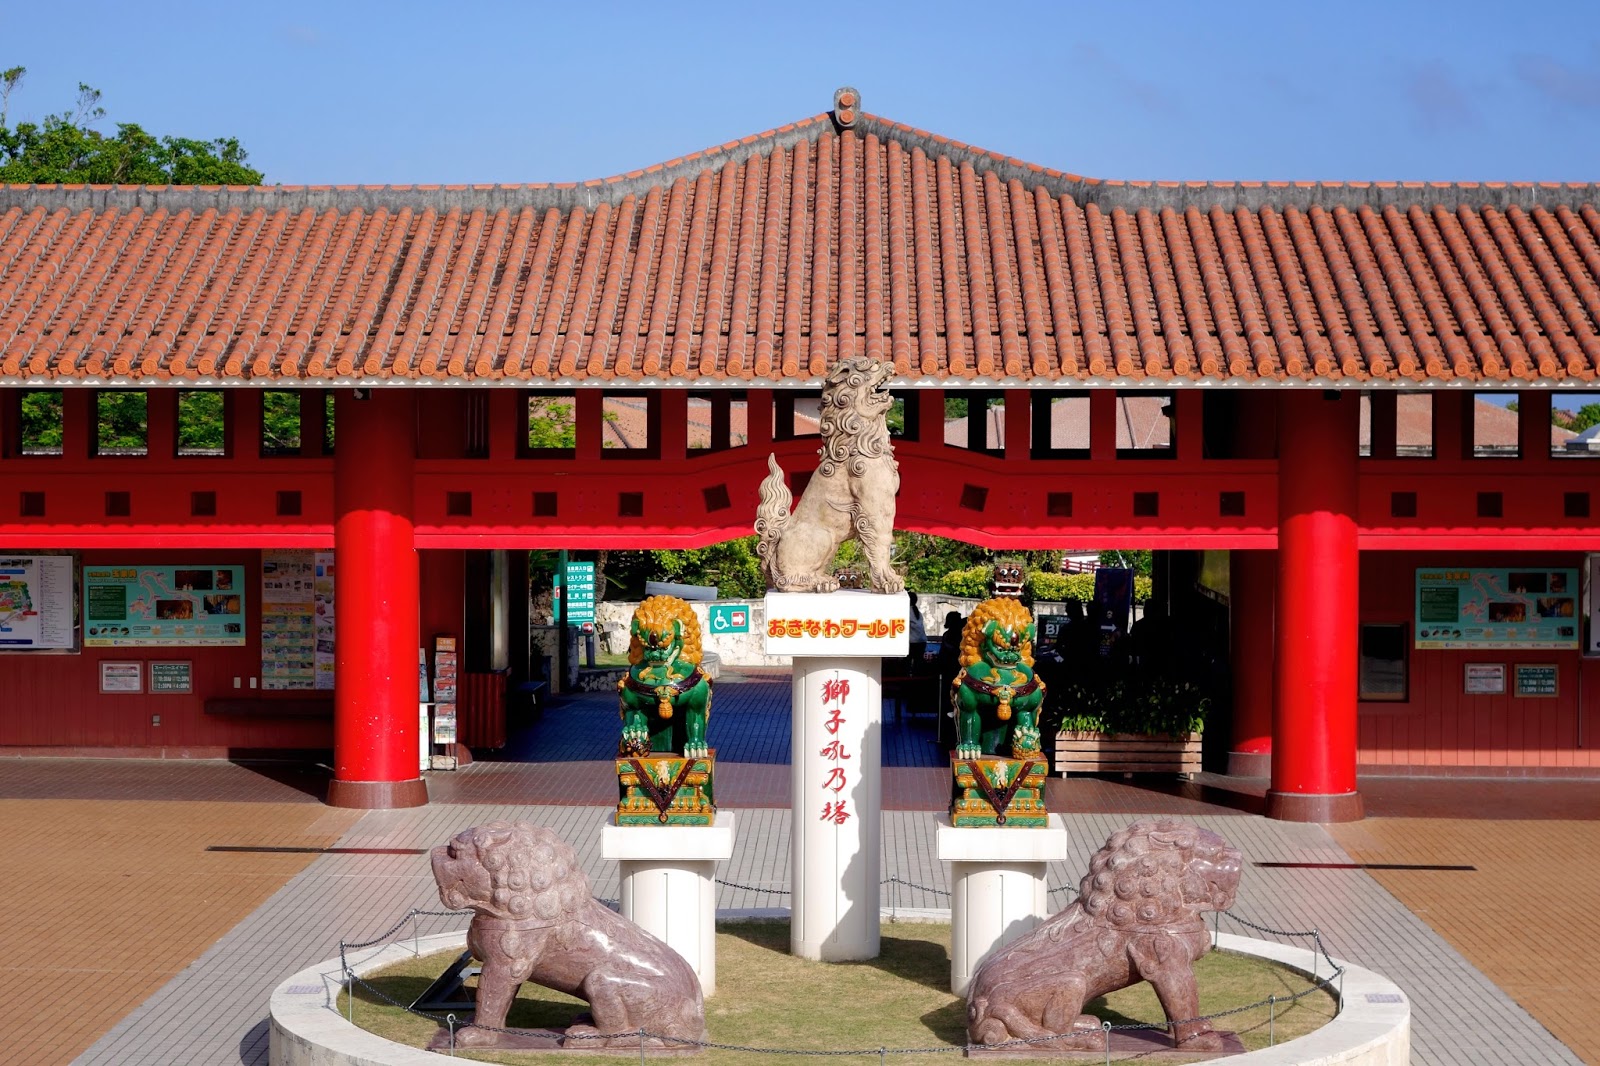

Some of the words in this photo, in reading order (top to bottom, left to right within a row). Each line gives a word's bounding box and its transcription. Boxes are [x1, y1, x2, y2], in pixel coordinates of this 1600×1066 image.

[767, 618, 906, 638] おきなわワールド
[819, 678, 852, 825] 獅子吼乃塔
